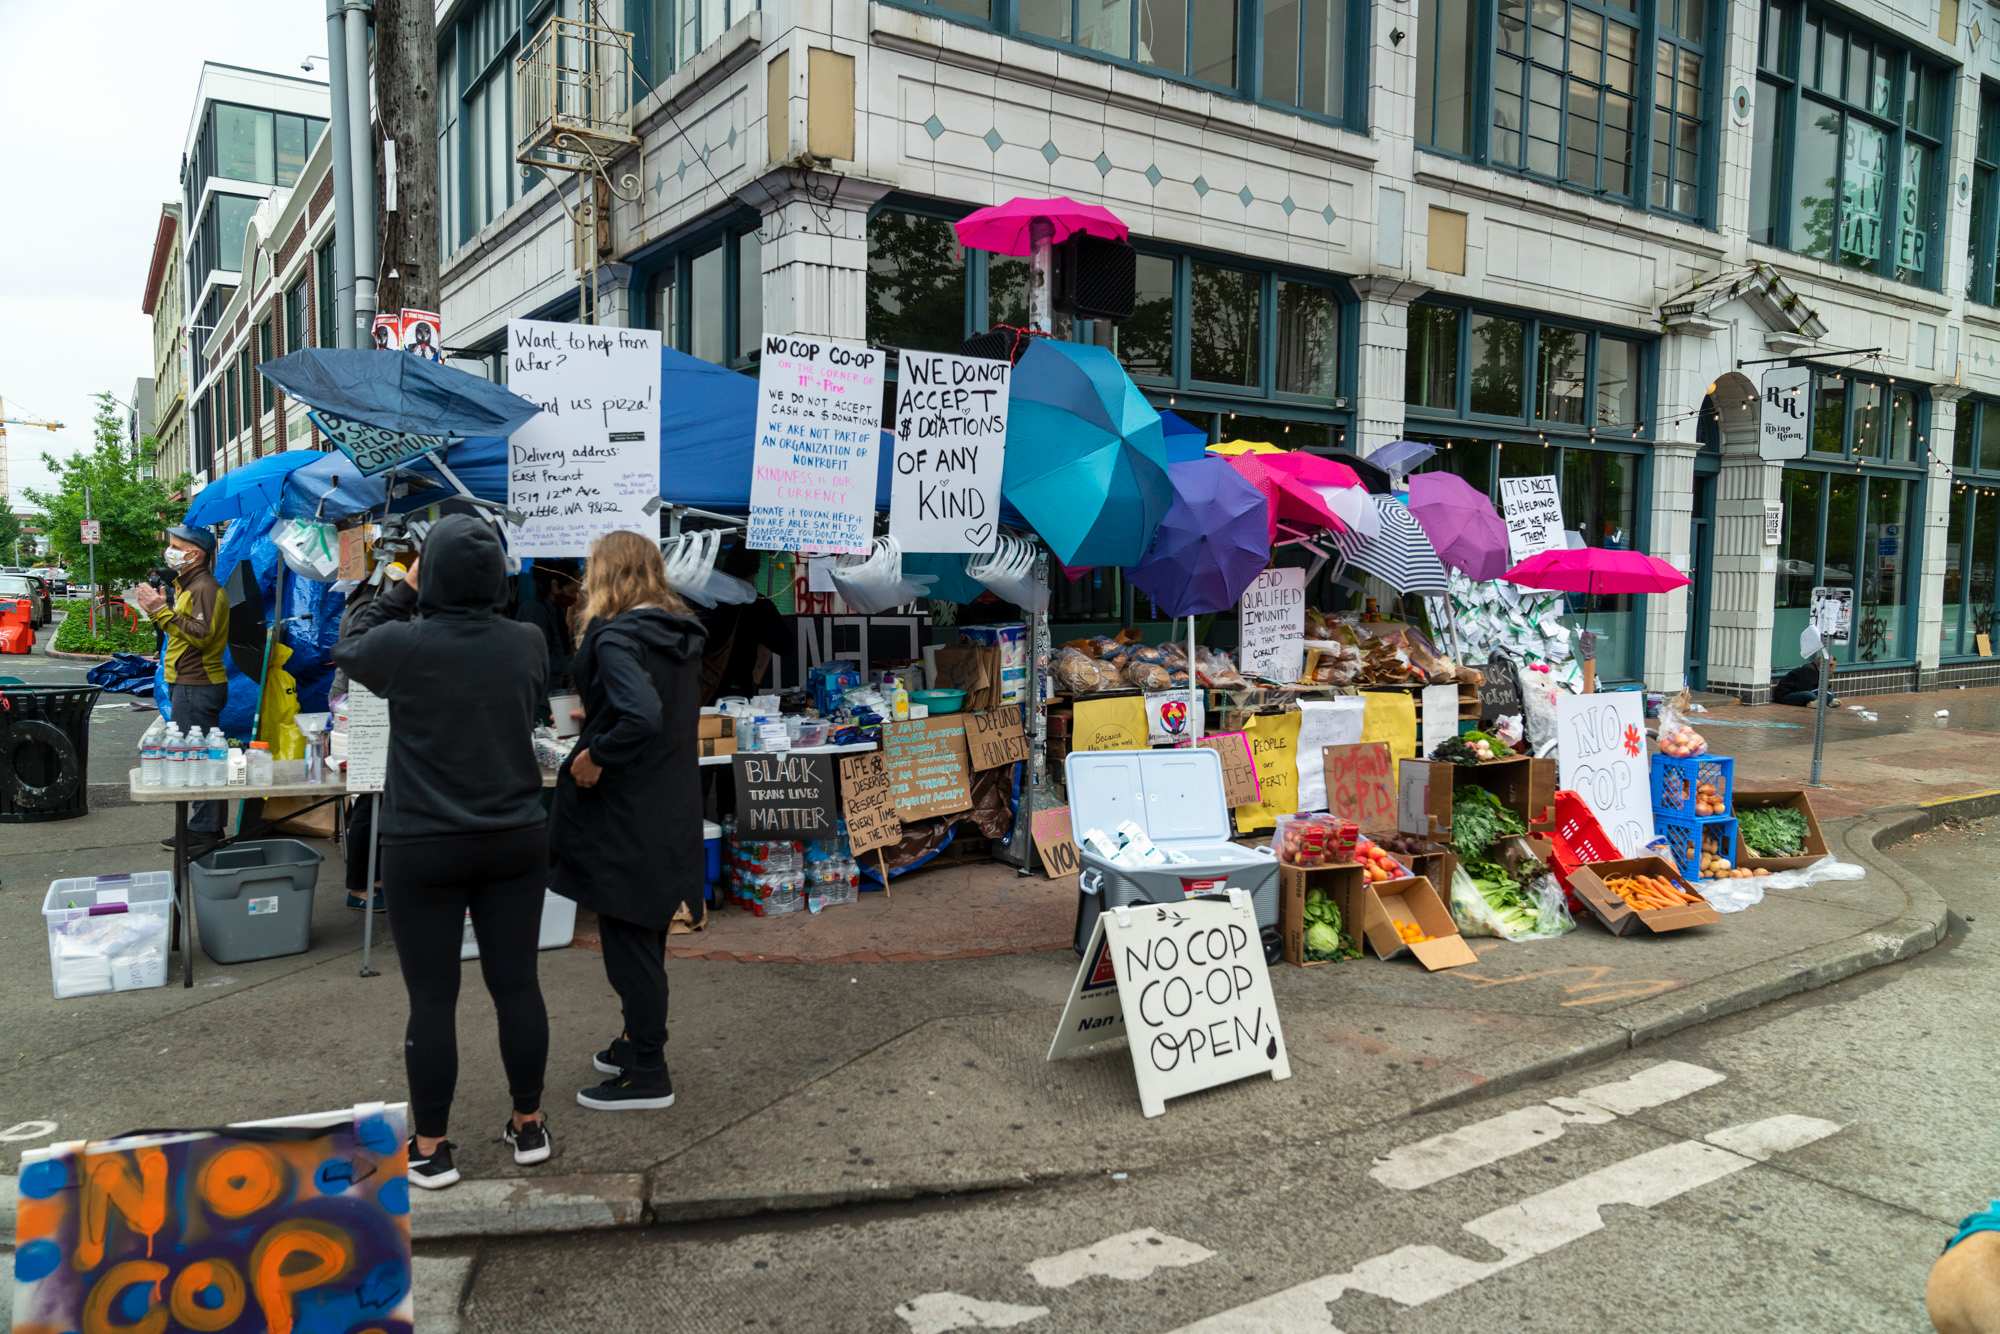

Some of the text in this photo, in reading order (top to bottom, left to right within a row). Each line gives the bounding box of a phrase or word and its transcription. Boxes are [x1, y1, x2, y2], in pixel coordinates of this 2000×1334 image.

[515, 329, 649, 356] Want to help from
[766, 337, 875, 369] NO COP CO-OP
[515, 354, 567, 372] afar?
[905, 355, 1009, 385] WE DO NOT
[572, 398, 591, 410] us
[603, 385, 652, 428] pizza!
[768, 389, 873, 416] WE DO NOT ACCEPT
[899, 389, 998, 415] ACCEPT
[771, 404, 798, 416] CASH
[831, 412, 879, 428] DONATIONS
[768, 421, 783, 435] WE
[787, 424, 806, 437] ARE
[809, 426, 831, 441] NOT
[834, 428, 857, 443] PART
[898, 417, 912, 441] $
[349, 431, 393, 453] BELO
[761, 435, 776, 448] AN
[779, 438, 851, 457] ORGANIZATION
[512, 445, 565, 471] Delivery
[792, 454, 848, 472] NONPROFIT
[897, 445, 978, 475] OF ANY
[512, 470, 536, 482] East
[756, 465, 815, 486] KINDNESS
[576, 486, 600, 496] Ave
[1504, 479, 1552, 496] IT IS NOT
[565, 503, 583, 515] WA
[752, 505, 784, 516] DONATE
[800, 508, 814, 517] YOU
[832, 511, 855, 523] HELP
[1505, 498, 1555, 516] US HELPING
[752, 516, 766, 526] YOU
[767, 517, 783, 527] ARE
[814, 519, 830, 530] SAY
[1508, 511, 1560, 529] THEM WE ARE
[750, 527, 793, 536] SOMEONE
[1520, 526, 1547, 543] THEM!
[1258, 572, 1283, 589] END
[1243, 588, 1302, 610] QUALIFIED
[1244, 608, 1291, 626] IMMUNITY
[975, 707, 1020, 733] DEFUND
[1570, 705, 1621, 758] NO
[1254, 738, 1287, 755] PEOPLE
[745, 757, 823, 783] BLACK
[843, 757, 869, 780] LIFE
[749, 788, 819, 800] TRANS LIVES
[1571, 760, 1632, 812] COP
[848, 790, 887, 816] RESPECT
[750, 807, 829, 830] MATTER
[849, 813, 874, 832] EVERY
[867, 828, 882, 841] THE
[881, 823, 902, 839] TIME
[1126, 924, 1247, 982] NO COP
[1139, 965, 1253, 1028] CO-OP
[1078, 1016, 1114, 1032] Nan
[76, 1143, 285, 1268] NO
[83, 1219, 354, 1334] COP
